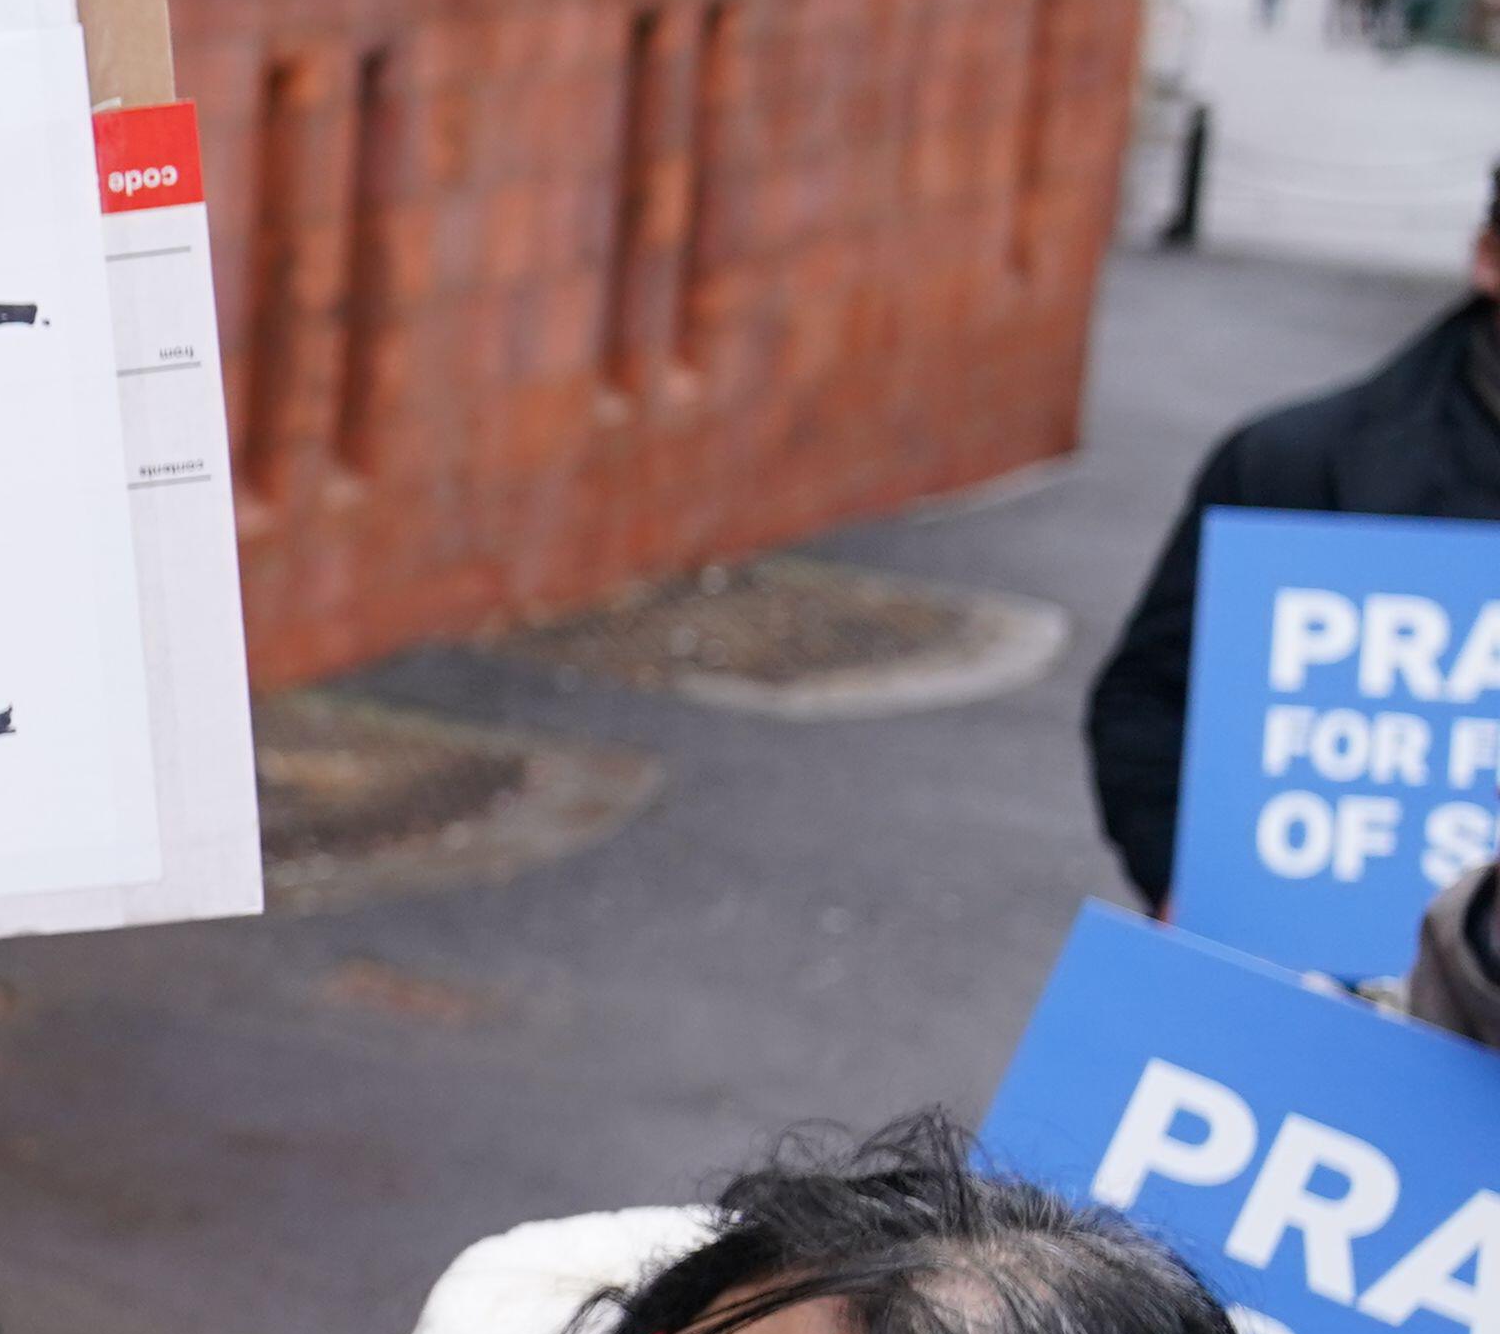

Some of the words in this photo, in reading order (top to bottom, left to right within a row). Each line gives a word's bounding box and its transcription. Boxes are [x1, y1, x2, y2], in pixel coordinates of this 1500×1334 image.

[107, 165, 178, 197] code
[1262, 703, 1432, 787] FOR
[1256, 789, 1402, 884] OF
